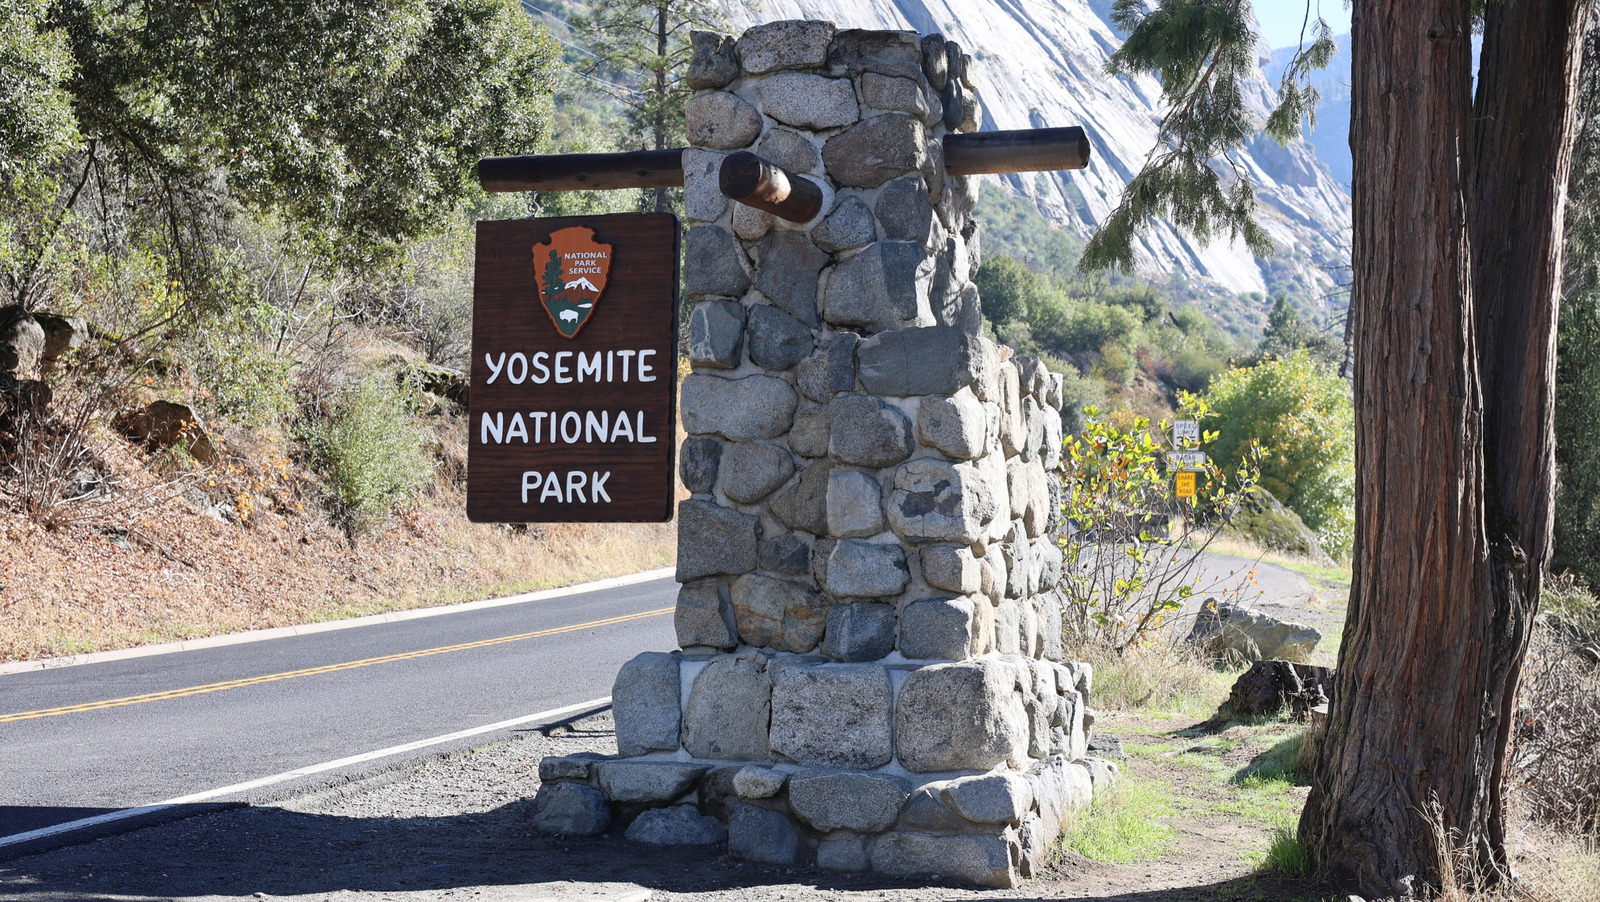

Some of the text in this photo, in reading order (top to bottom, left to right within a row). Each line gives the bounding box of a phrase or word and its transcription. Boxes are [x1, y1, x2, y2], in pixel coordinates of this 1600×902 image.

[564, 251, 607, 260] NATIONAL
[574, 259, 597, 267] PARK
[568, 266, 602, 275] SERVICE
[484, 349, 657, 385] YOSEMITE
[480, 410, 657, 445] NATIONAL
[521, 470, 612, 504] PARK
